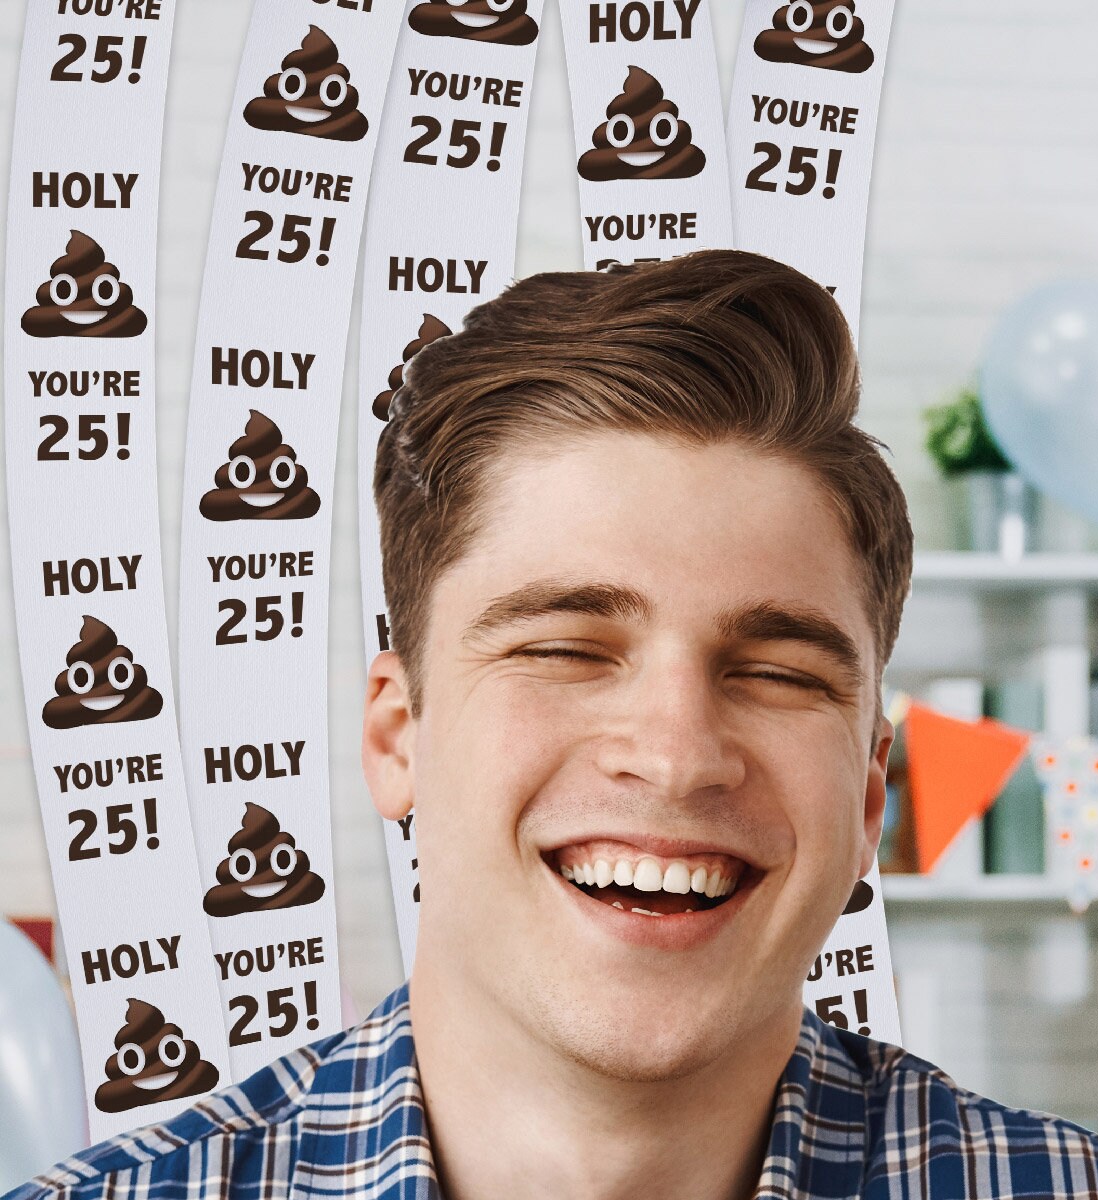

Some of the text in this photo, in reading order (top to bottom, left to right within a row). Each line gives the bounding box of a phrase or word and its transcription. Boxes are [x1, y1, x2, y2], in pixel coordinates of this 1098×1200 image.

[590, 0, 701, 43] HOLY
[50, 34, 147, 84] 25!
[408, 68, 523, 107] YOU'RE
[752, 95, 858, 134] YOU'RE
[403, 116, 507, 172] 25!
[33, 172, 139, 208] HOLY
[242, 163, 353, 202] YOU'RE
[745, 142, 842, 199] 25!
[236, 211, 336, 266] 25!
[585, 213, 696, 241] YOU'RE
[389, 257, 488, 293] HOLY
[28, 371, 139, 397] YOU'RE
[212, 347, 316, 389] HOLY
[38, 413, 130, 461] 25!
[43, 555, 142, 596] HOLY
[207, 551, 313, 582] YOU'RE
[216, 592, 303, 645] 25!
[53, 754, 163, 793] YOU'RE
[204, 741, 305, 784] HOLY
[68, 798, 159, 861] 25!
[82, 935, 181, 984] HOLY
[214, 937, 324, 981] YOU'RE
[806, 945, 874, 981] U'RE
[229, 981, 319, 1047] 25!
[815, 989, 871, 1036] 5!
